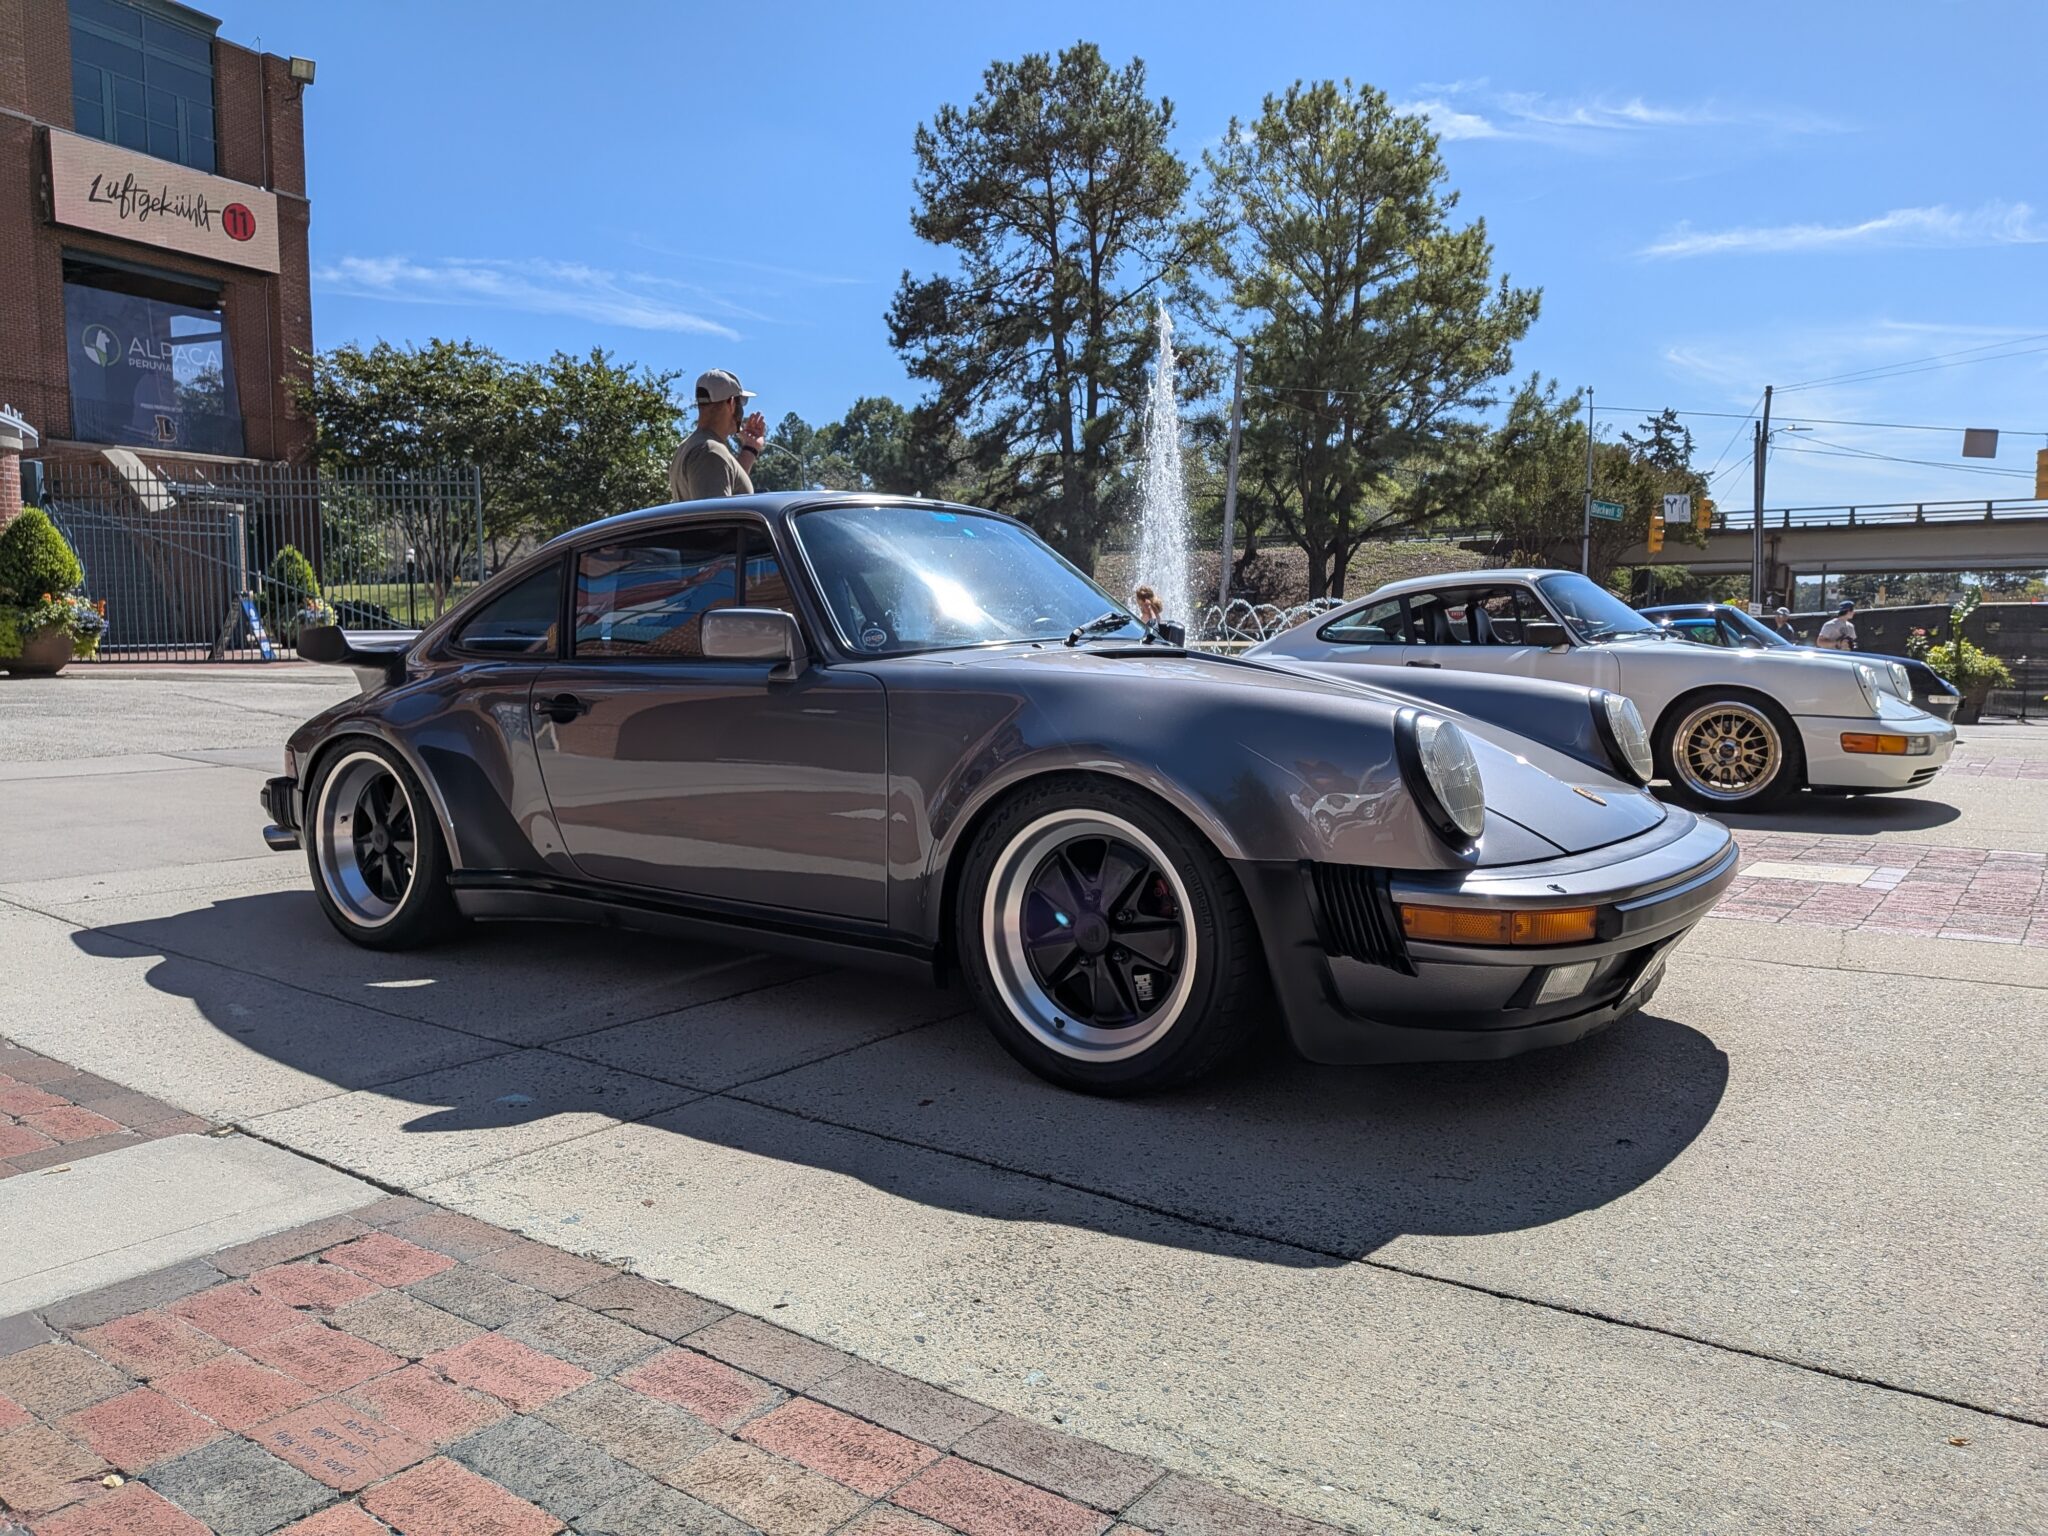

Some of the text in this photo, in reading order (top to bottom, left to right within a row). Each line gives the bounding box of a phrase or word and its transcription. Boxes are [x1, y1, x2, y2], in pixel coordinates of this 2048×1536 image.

[88, 172, 221, 232] Luftgekühlt
[128, 336, 220, 370] ALPACA
[322, 1457, 356, 1478] Lance
